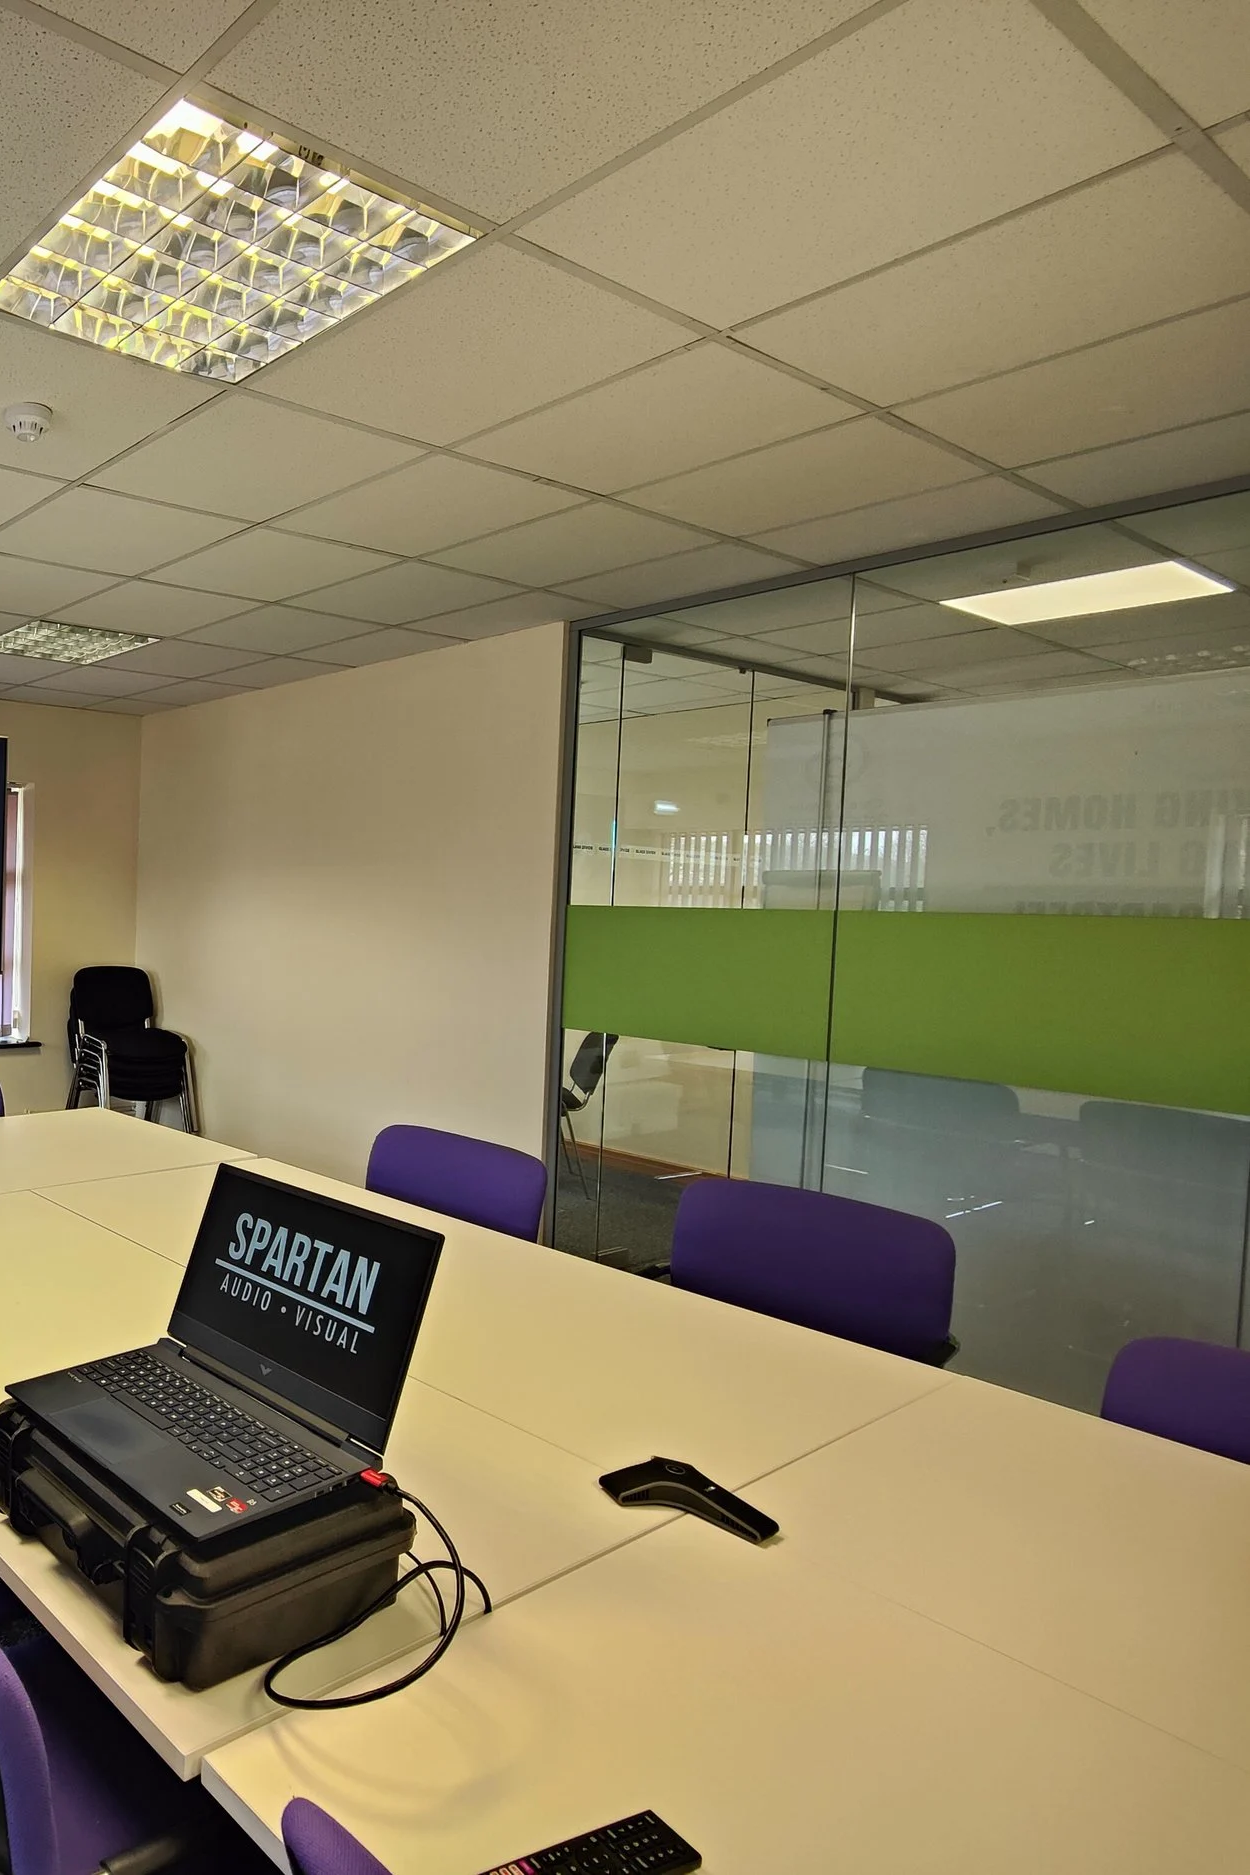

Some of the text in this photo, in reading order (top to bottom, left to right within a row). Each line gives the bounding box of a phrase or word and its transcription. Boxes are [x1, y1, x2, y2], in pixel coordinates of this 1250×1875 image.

[228, 1212, 381, 1316] SPARTAN
[219, 1272, 360, 1355] AUDIO VISUAL
